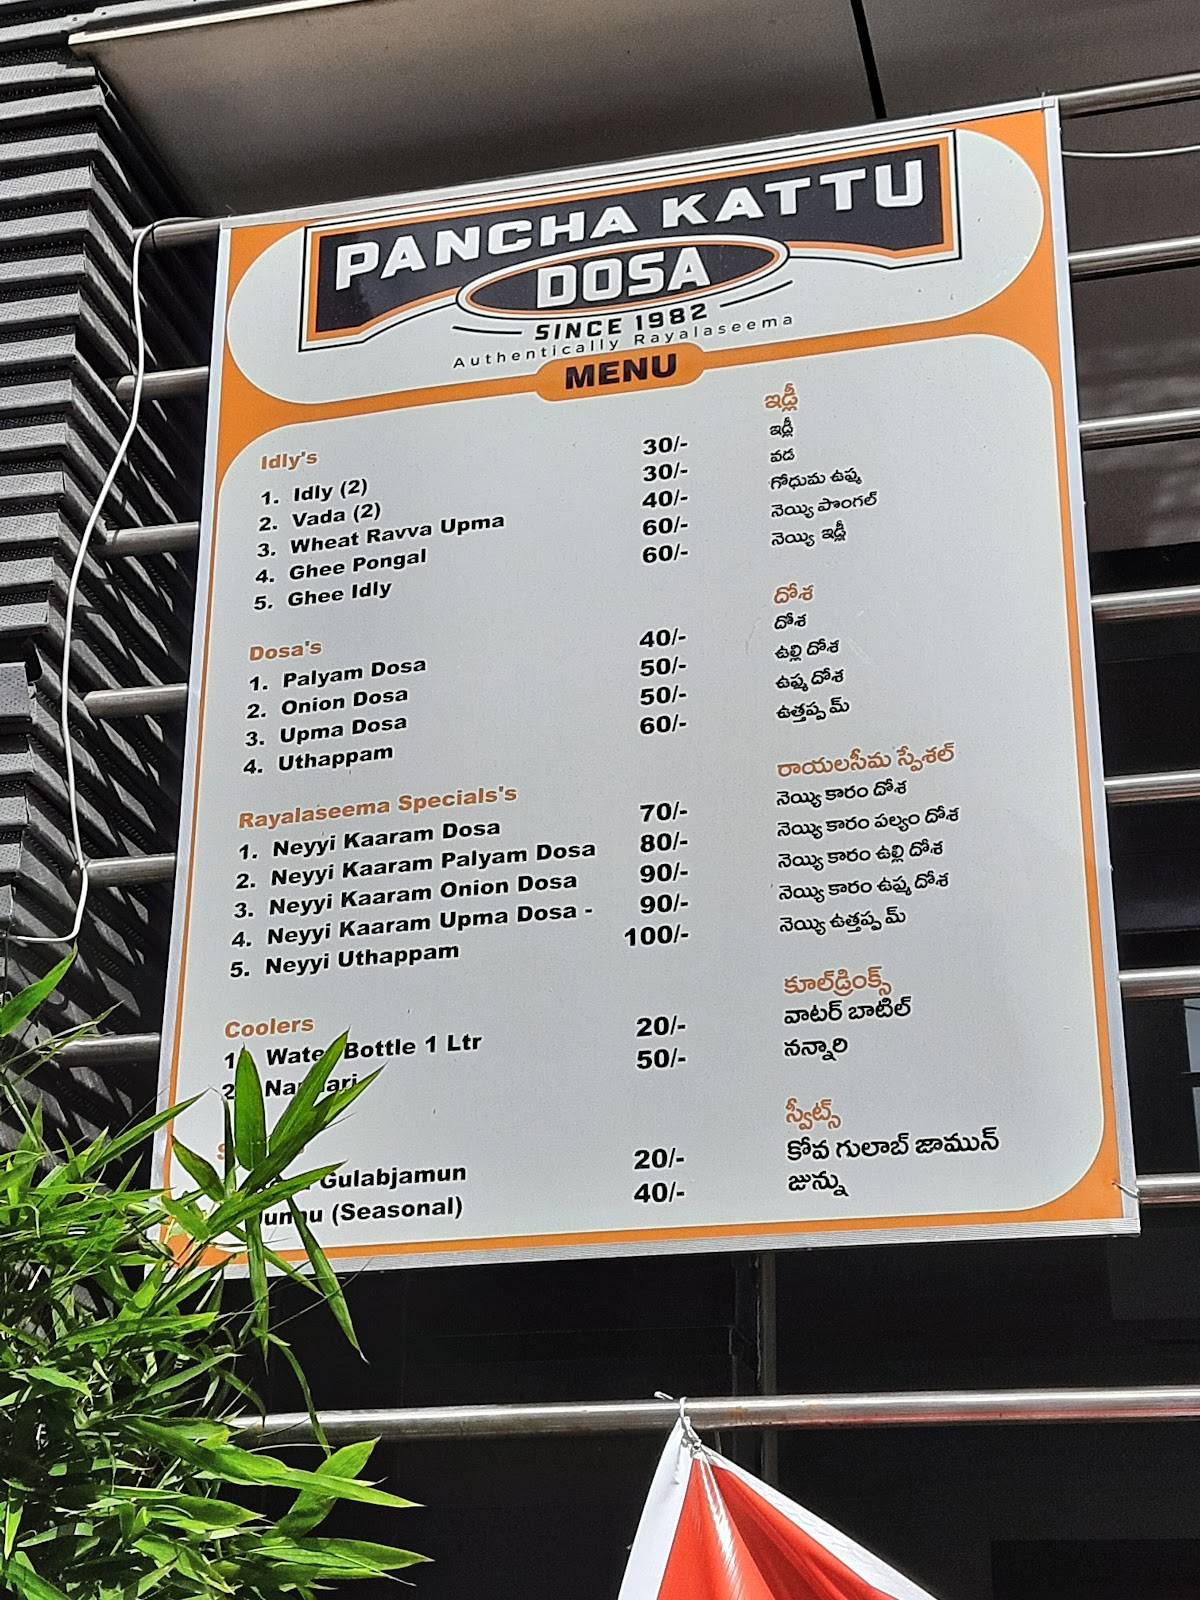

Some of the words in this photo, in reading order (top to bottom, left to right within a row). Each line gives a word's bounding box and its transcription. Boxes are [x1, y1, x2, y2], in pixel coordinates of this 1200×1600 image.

[334, 205, 637, 291] PANCHA
[662, 158, 926, 230] KATTU
[535, 246, 712, 308] DOSA
[535, 318, 622, 340] SINCE
[635, 303, 709, 331] 1982
[453, 339, 618, 368] Authentically
[635, 312, 792, 345] Rayalaseema
[565, 353, 678, 389] MENU
[643, 436, 687, 455] 30/-
[771, 448, 795, 462] వడ
[262, 452, 317, 470] Idly's
[643, 462, 687, 481] 30/-
[261, 491, 278, 505] 1.
[294, 485, 333, 502] Idly
[341, 479, 367, 499] (2)
[642, 489, 688, 508] 40/-
[259, 517, 277, 531] 2.
[292, 509, 345, 527] Vada
[354, 502, 380, 523] (2)
[643, 516, 688, 535] 60/-
[257, 543, 275, 557] 3.
[291, 532, 359, 553] Wheat
[367, 525, 431, 543] Ravva
[441, 517, 504, 535] Upma
[643, 544, 688, 563] 60/-
[256, 569, 274, 583] 4.
[290, 564, 345, 580] Ghee
[353, 549, 426, 572] Pongal
[254, 596, 272, 610] 5.
[288, 590, 344, 606] Ghee
[352, 581, 392, 598] Idly
[774, 583, 813, 603] దోశ
[774, 612, 806, 629] దోశ
[640, 628, 686, 647] 40/-
[807, 638, 839, 655] దోశ
[250, 641, 321, 660] Dosa's
[250, 676, 267, 691] 1.
[284, 668, 362, 688] Palyam
[372, 661, 425, 677] Dosa
[640, 656, 686, 676] 50/-
[811, 668, 844, 685] దోశ
[247, 704, 266, 719] 2.
[282, 697, 344, 715] Onion
[354, 690, 407, 706] Dosa
[641, 685, 686, 705] 50/-
[245, 731, 264, 746] 3.
[281, 726, 343, 745] Upma
[352, 718, 406, 734] Dosa
[640, 714, 686, 734] 60/-
[243, 759, 262, 774] 4.
[279, 747, 392, 770] Uthappam
[825, 785, 868, 800] కారం
[873, 778, 907, 796] దోశ
[240, 802, 389, 829] Rayalaseema
[399, 786, 516, 813] Specials's
[640, 801, 687, 822] 70/-
[826, 817, 869, 832] కారం
[925, 805, 959, 823] దోశ
[239, 844, 257, 859] 1.
[274, 835, 335, 857] Neyyi
[344, 829, 433, 849] Kaaram
[443, 823, 500, 839] Dosa
[640, 832, 687, 852] 80/-
[827, 848, 871, 863] కారం
[909, 839, 943, 857] దోశ
[236, 874, 255, 889] 2.
[272, 864, 334, 886] Neyyi
[343, 858, 432, 878] Kaaram
[442, 850, 527, 869] Palyam
[537, 844, 595, 860] Dosa
[640, 862, 688, 883] 90/-
[828, 880, 872, 895] కారం
[915, 870, 949, 889] దోశ
[234, 903, 253, 918] 3.
[270, 894, 332, 916] Neyyi
[341, 888, 431, 907] Kaaram
[440, 880, 508, 898] Onion
[518, 876, 576, 892] Dosa
[640, 893, 688, 914] 90/-
[232, 932, 251, 947] 4.
[268, 923, 331, 945] Neyyi
[340, 918, 430, 937] Kaaram
[440, 912, 507, 931] Upma
[518, 906, 576, 922] Dosa
[625, 924, 688, 946] 100/-
[231, 961, 249, 977] 5.
[266, 953, 329, 976] Neyyi
[339, 946, 458, 967] Uthappam
[226, 1018, 313, 1038] Coolers
[637, 1015, 685, 1037] 20/-
[266, 1047, 324, 1066] Wate
[344, 1038, 416, 1060] Bottle
[426, 1036, 435, 1053] 1
[448, 1034, 482, 1051] Ltr
[637, 1048, 686, 1069] 50/-
[265, 1073, 357, 1097] Naari
[634, 1148, 684, 1169] 20/-
[320, 1166, 466, 1190] Gulabjamun
[634, 1182, 684, 1203] 40/-
[333, 1196, 462, 1226] (Seasonal)
